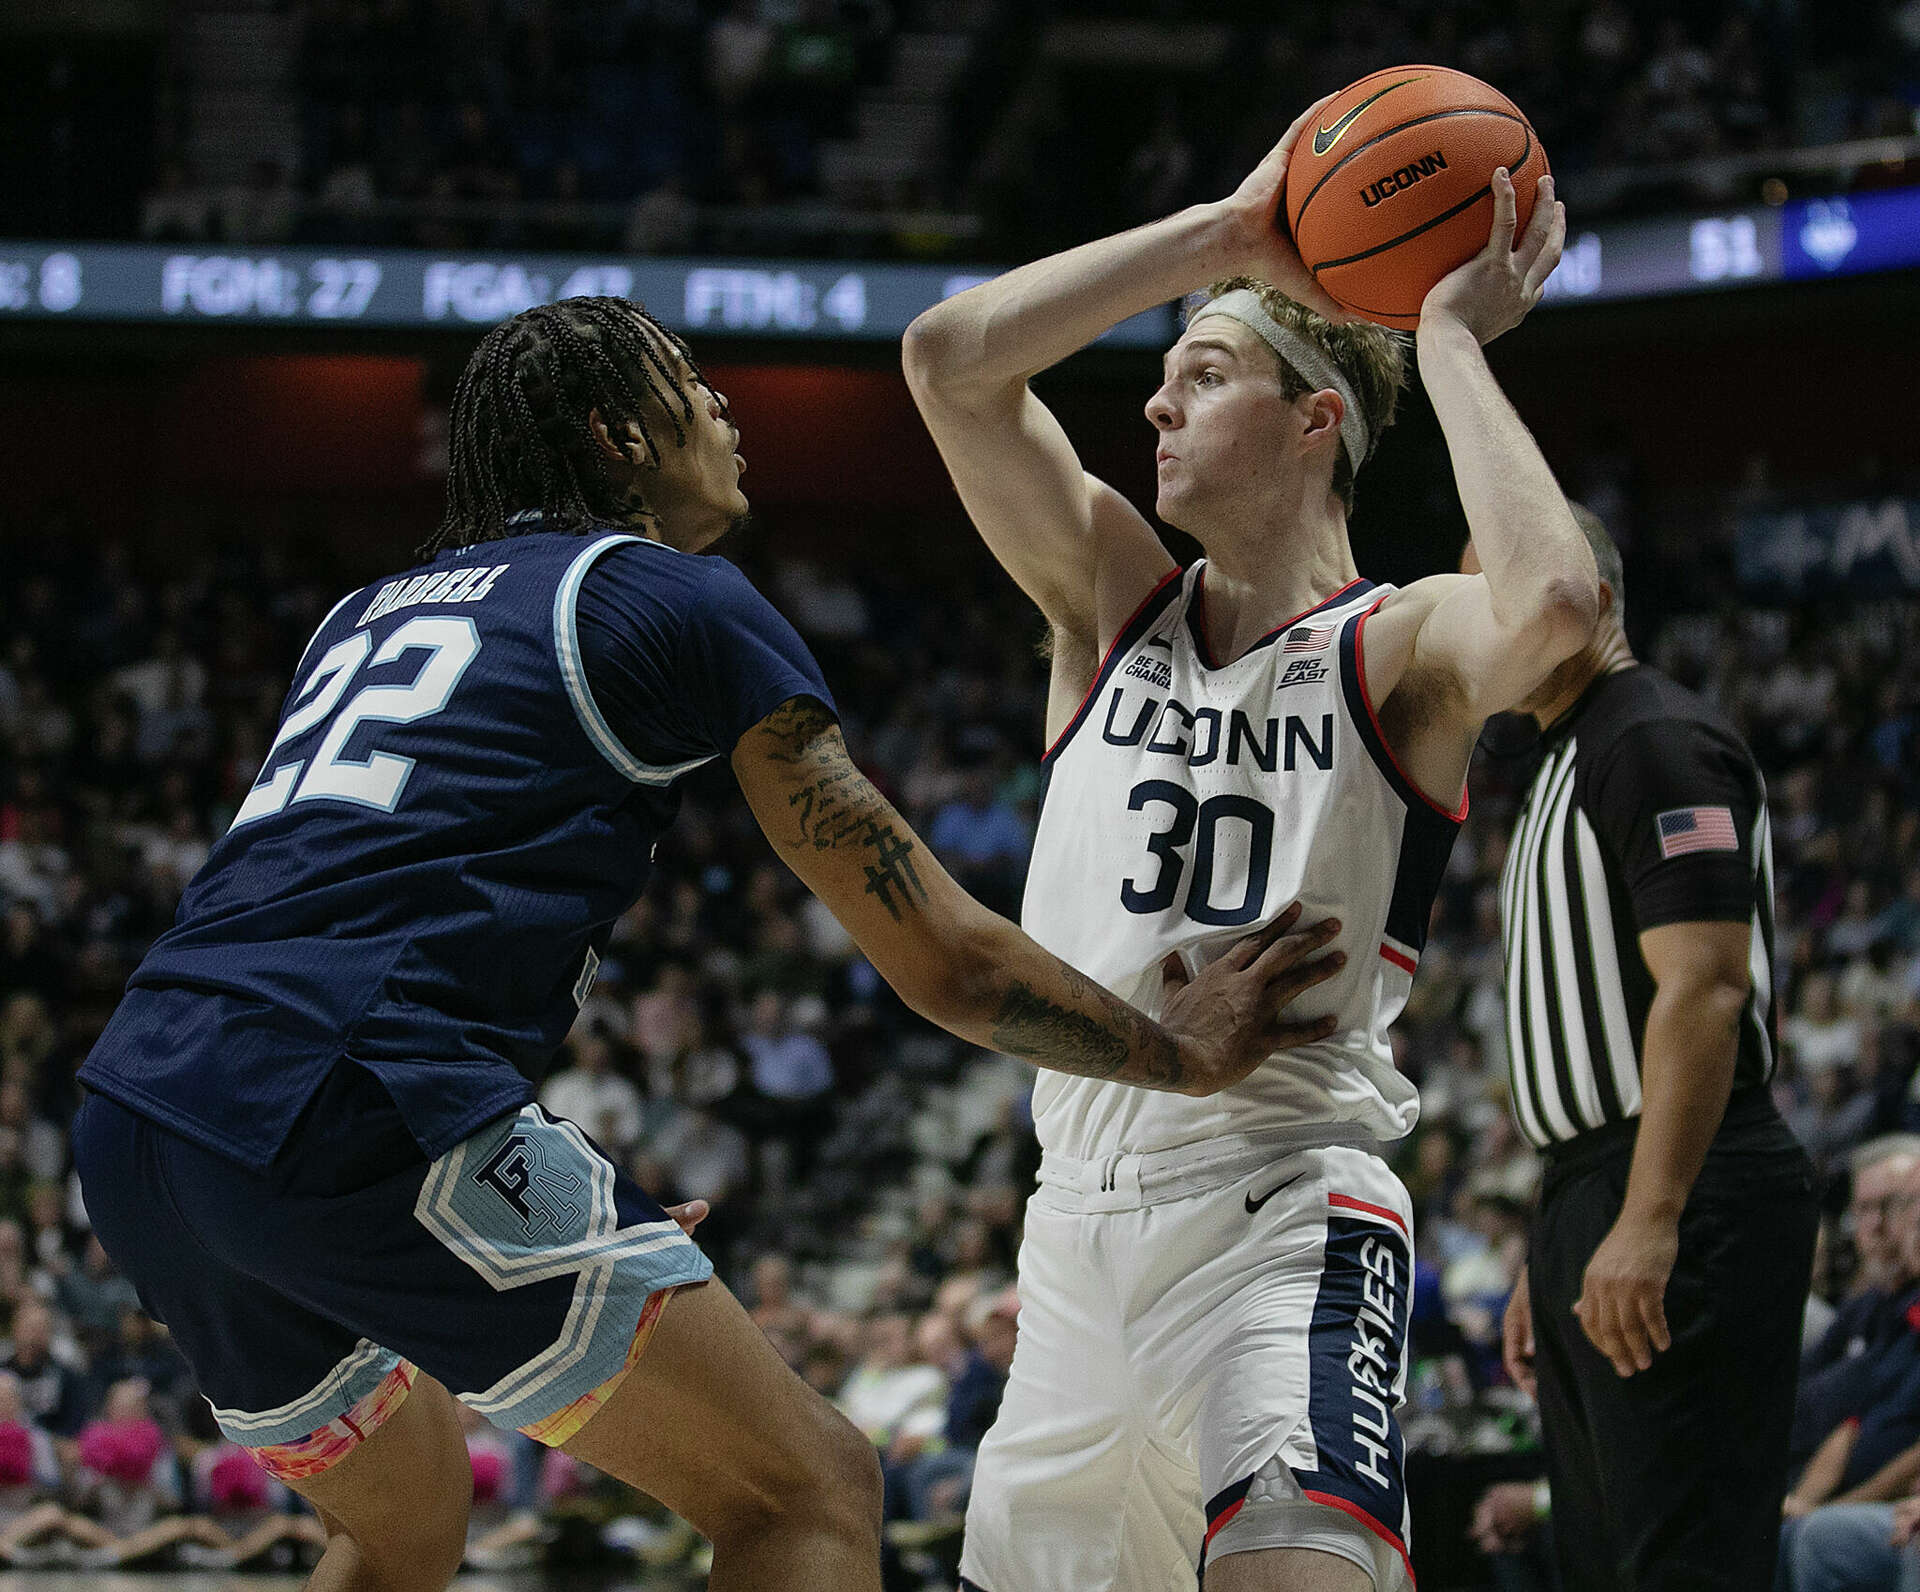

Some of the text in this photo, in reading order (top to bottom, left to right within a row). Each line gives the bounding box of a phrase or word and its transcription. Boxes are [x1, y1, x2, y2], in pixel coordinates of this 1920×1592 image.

[1360, 151, 1448, 207] UCONN
[308, 258, 381, 318] 27
[825, 272, 867, 332] 4
[355, 563, 510, 628] FARRELL
[1134, 655, 1154, 668] BE
[1280, 668, 1329, 684] EAST
[1286, 658, 1322, 672] BIG
[226, 615, 483, 836] 22
[1102, 688, 1334, 772] UCONN
[1120, 779, 1275, 926] 30
[1347, 1236, 1395, 1489] HUSKIES
